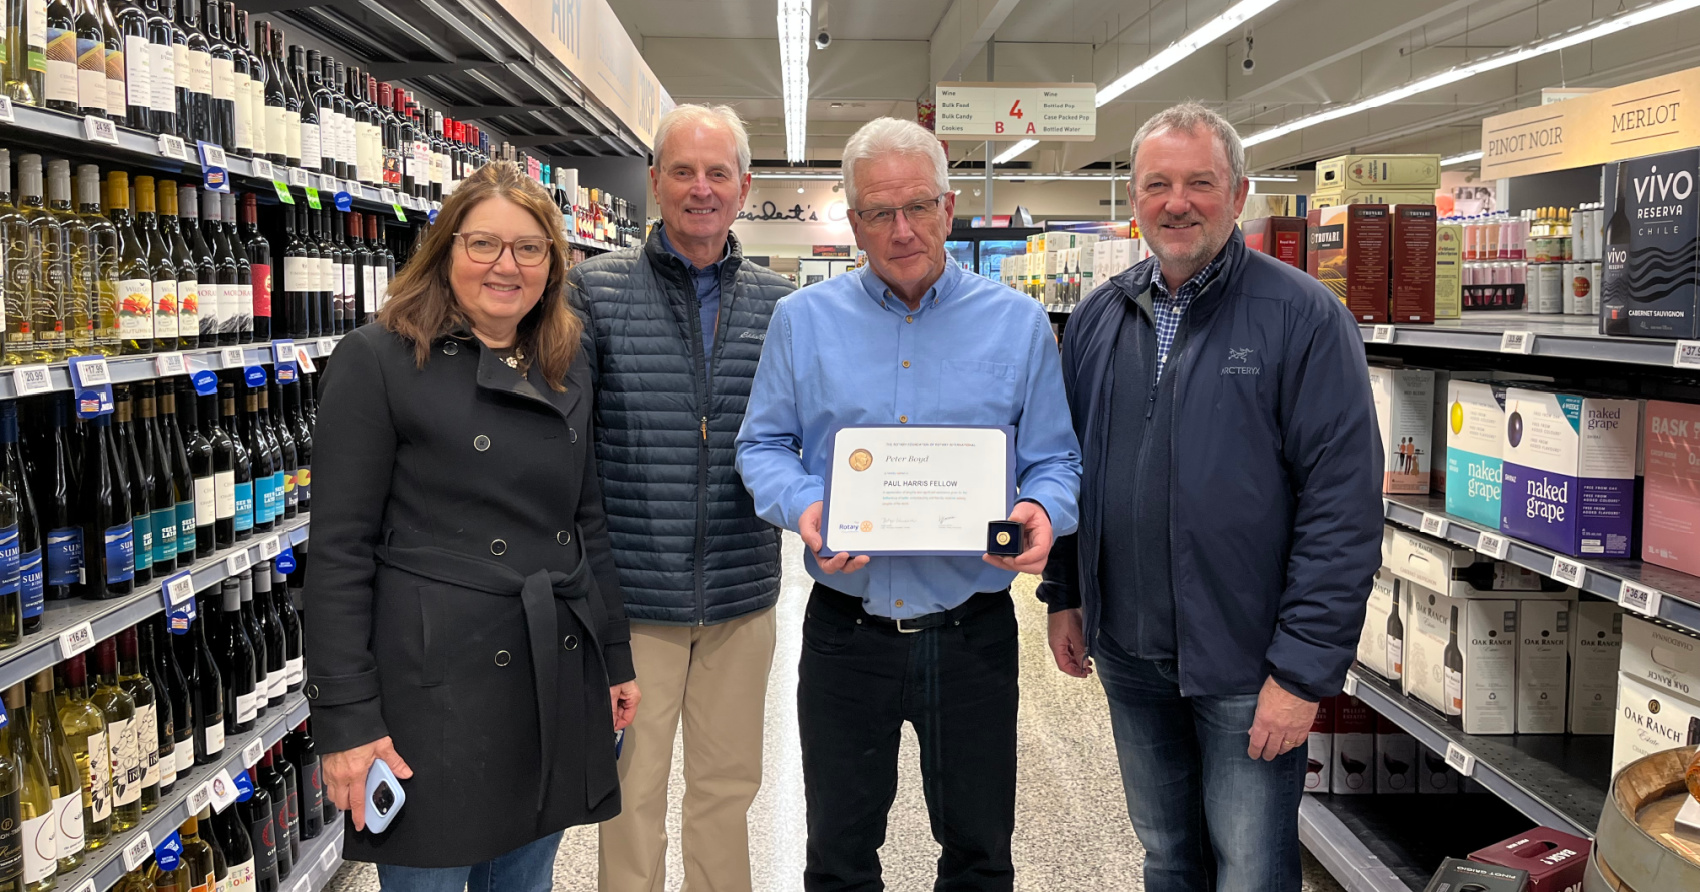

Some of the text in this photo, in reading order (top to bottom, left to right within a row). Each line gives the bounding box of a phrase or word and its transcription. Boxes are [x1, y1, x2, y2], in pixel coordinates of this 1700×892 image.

[1009, 99, 1023, 119] 4
[955, 113, 973, 121] Candy
[1611, 102, 1680, 134] MERLOT
[995, 121, 1005, 134] B
[1026, 121, 1036, 134] A
[1488, 126, 1563, 157] PINOT NOIR
[737, 201, 818, 221] esident's
[1637, 204, 1683, 219] RESERVA
[1315, 231, 1340, 243] TRUVARI
[1639, 225, 1679, 236] CHILE
[1653, 310, 1685, 318] SAUVIGNON
[1508, 334, 1522, 343] 33.99
[88, 364, 104, 374] 17.99
[24, 371, 44, 382] 20.99
[1588, 407, 1621, 419] naked
[1587, 418, 1619, 431] grape
[1652, 416, 1690, 438] BASK
[885, 455, 929, 463] Peter Boyd
[1468, 460, 1503, 484] naked
[1468, 478, 1501, 502] grape
[1527, 477, 1568, 504] naked
[1526, 497, 1565, 524] grape
[839, 523, 859, 531] Rotary
[1409, 539, 1433, 554] OAK RANCH
[1560, 563, 1577, 576] 36.49
[1630, 588, 1648, 602] 36.49
[1415, 601, 1449, 625] OAK RANCH
[72, 629, 88, 642] 16.49
[1541, 638, 1564, 646] RANCH
[1651, 631, 1694, 652] CHARDONNAY
[1647, 669, 1690, 694] OAK RANCH
[1624, 706, 1644, 726] OAK
[1546, 848, 1577, 862] BASK
[229, 866, 250, 880] ET'S
[1456, 866, 1516, 879] PINOT GRIGIO
